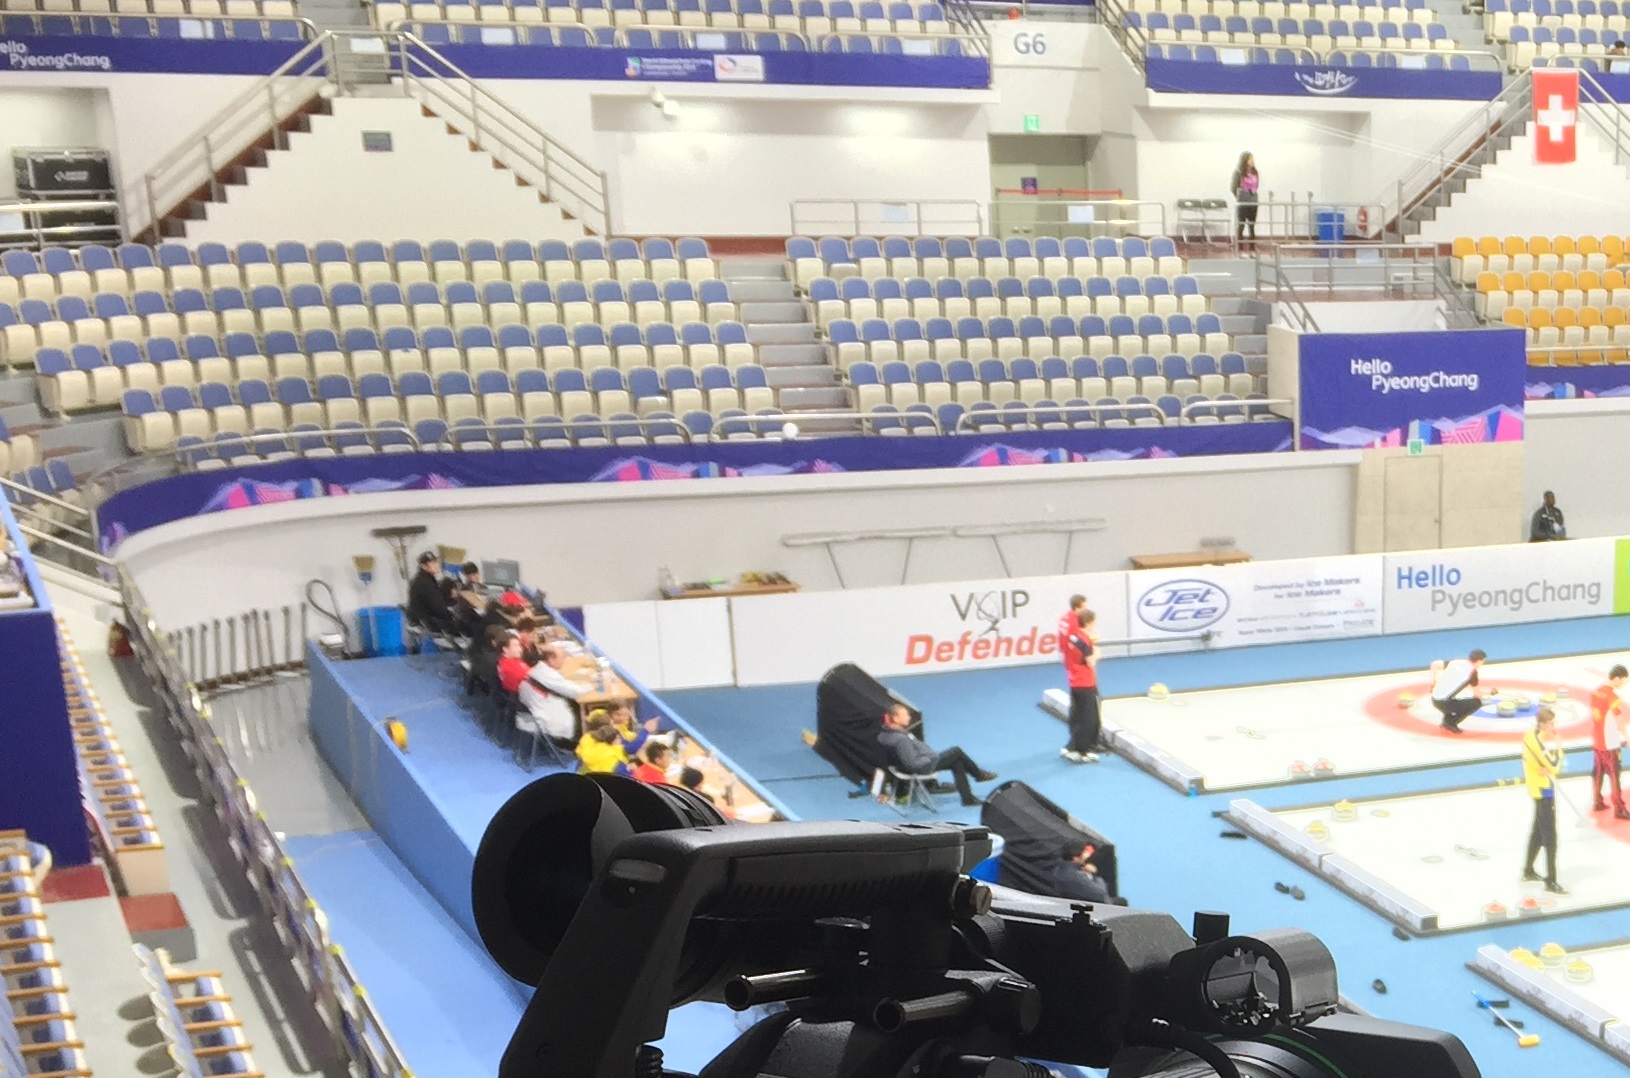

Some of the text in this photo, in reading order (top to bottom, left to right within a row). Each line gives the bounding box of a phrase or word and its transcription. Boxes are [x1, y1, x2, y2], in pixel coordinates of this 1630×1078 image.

[0, 40, 27, 54] ello
[1013, 32, 1047, 55] G6
[10, 52, 111, 70] PyeongChang
[1351, 358, 1392, 375] Hello
[1372, 371, 1479, 394] PyeongChang
[1396, 564, 1461, 589] Hello
[1144, 587, 1217, 607] Jet
[1430, 579, 1601, 617] PyeongChang
[1158, 605, 1218, 623] Ice
[904, 626, 1058, 666] Defende
